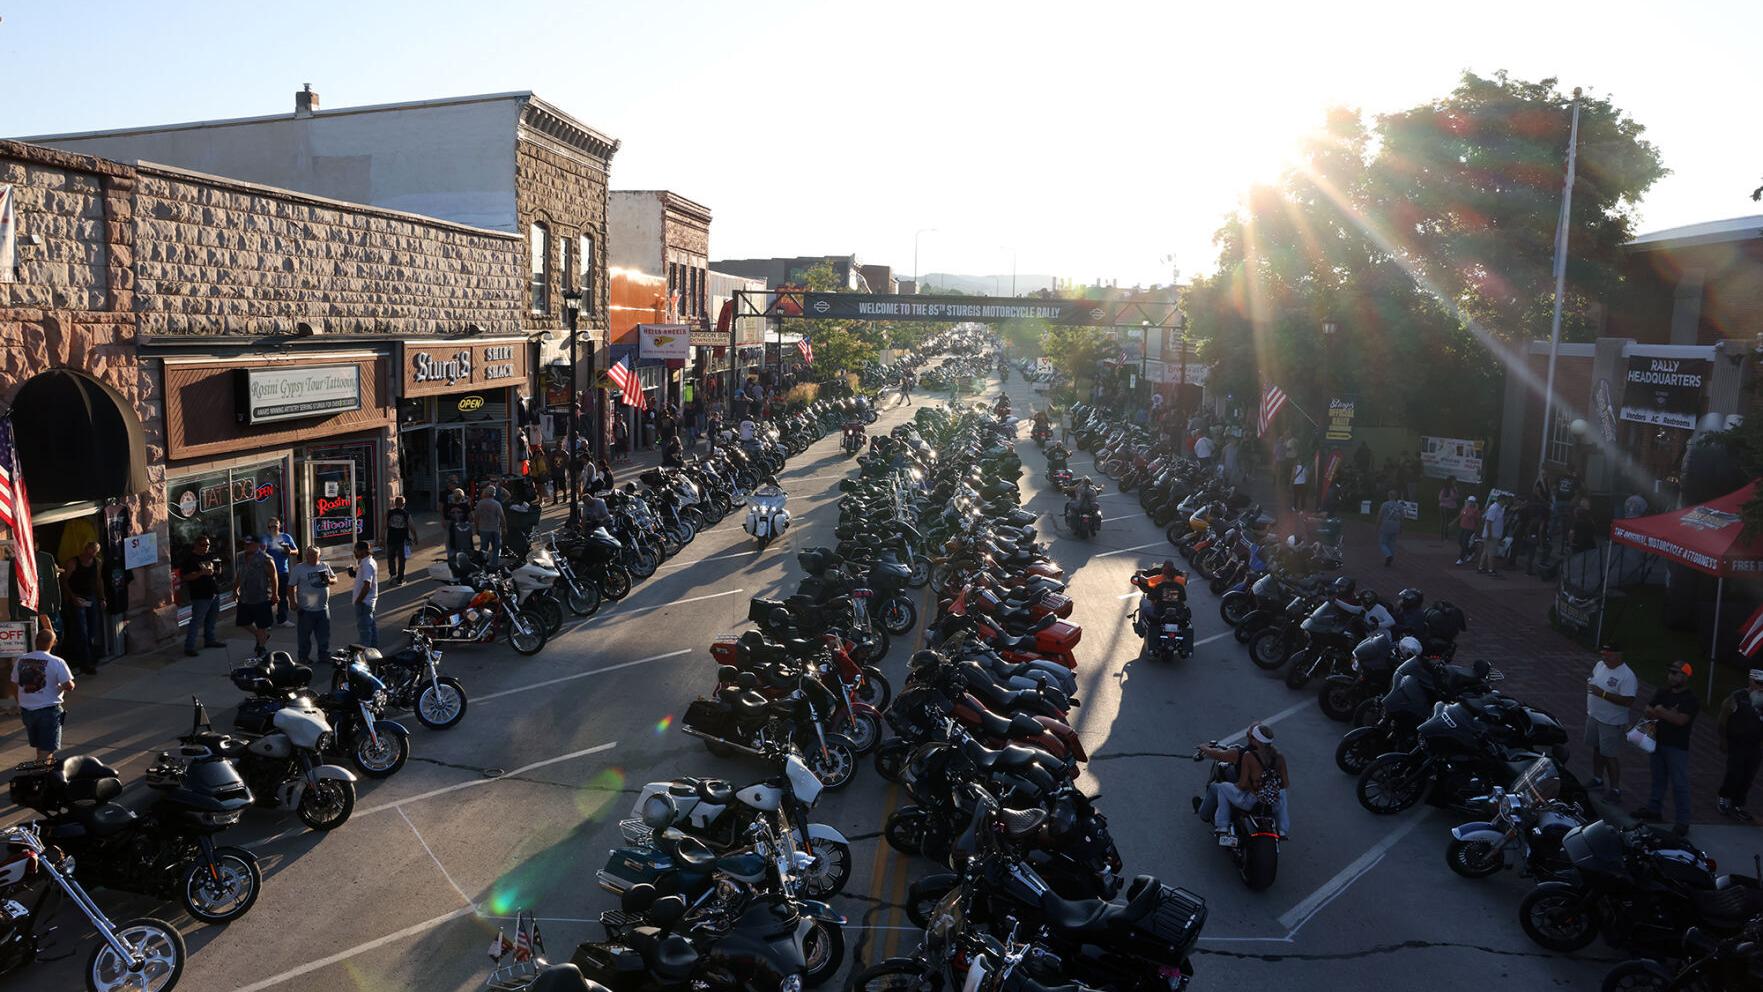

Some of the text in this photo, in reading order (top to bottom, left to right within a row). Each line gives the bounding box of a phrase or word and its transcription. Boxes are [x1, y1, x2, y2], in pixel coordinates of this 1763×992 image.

[859, 302, 899, 314] WELCOME
[900, 303, 910, 315] TO
[912, 303, 927, 315] THE
[946, 304, 981, 317] STURGIS
[982, 306, 1036, 318] MOTORCYCLE
[1037, 307, 1060, 319] RALLY
[486, 346, 514, 361] SHIRT
[486, 363, 514, 379] SHACK
[1650, 360, 1681, 373] RALLY
[1627, 370, 1702, 388] HEADQUARTERS
[252, 375, 358, 399] Rosini Gypsy Tour Tattooing
[459, 399, 482, 409] OPEN
[1626, 411, 1646, 421] Vendors
[1651, 415, 1660, 423] AC
[255, 484, 274, 500] OPEN
[1615, 527, 1624, 537] THE
[1648, 537, 1683, 557] MOTORCYCLE
[1683, 549, 1718, 570] ATTORNEYS
[1732, 560, 1755, 571] FREE
[0, 630, 24, 641] OFF
